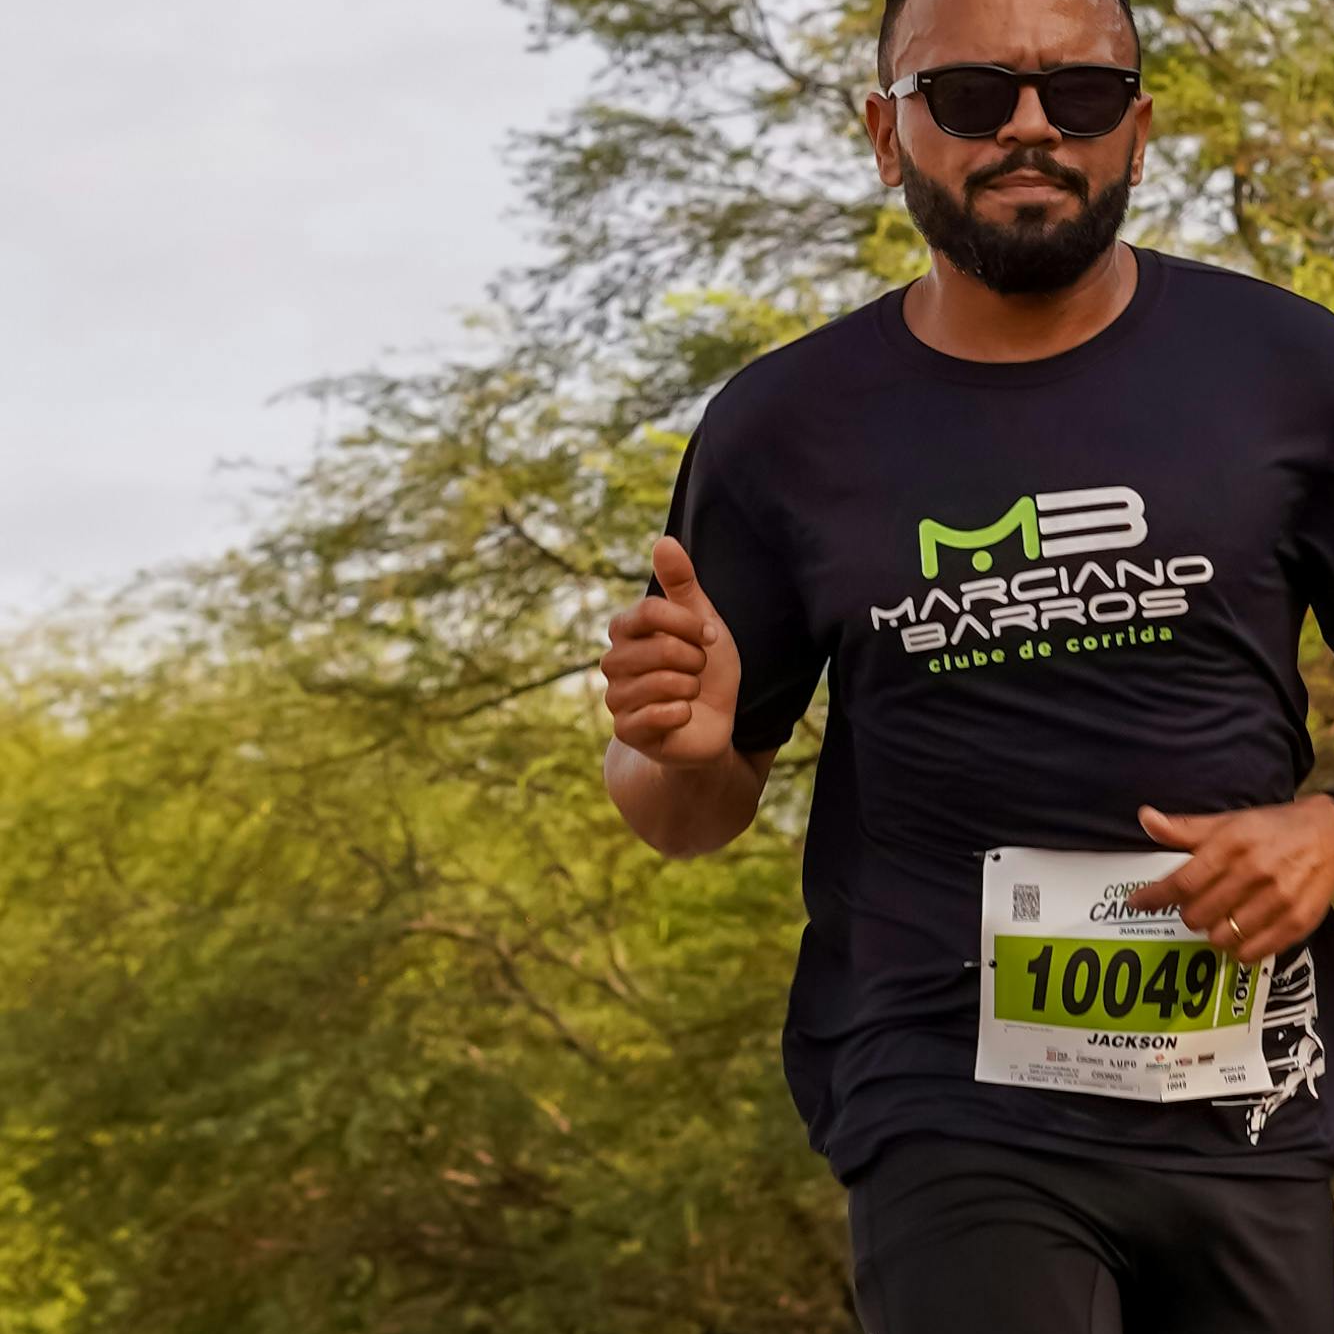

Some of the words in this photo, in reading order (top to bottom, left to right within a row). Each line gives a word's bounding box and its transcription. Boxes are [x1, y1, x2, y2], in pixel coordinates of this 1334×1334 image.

[918, 485, 1149, 579] MB
[870, 555, 1214, 630] MARCIANO
[900, 588, 1189, 653] BARROS
[928, 647, 1005, 673] clube
[1019, 639, 1051, 660] de
[1065, 624, 1173, 653] corrida
[1026, 944, 1217, 1019] 10049
[1231, 961, 1252, 1018] 10K
[1087, 1033, 1178, 1050] JACKSON
